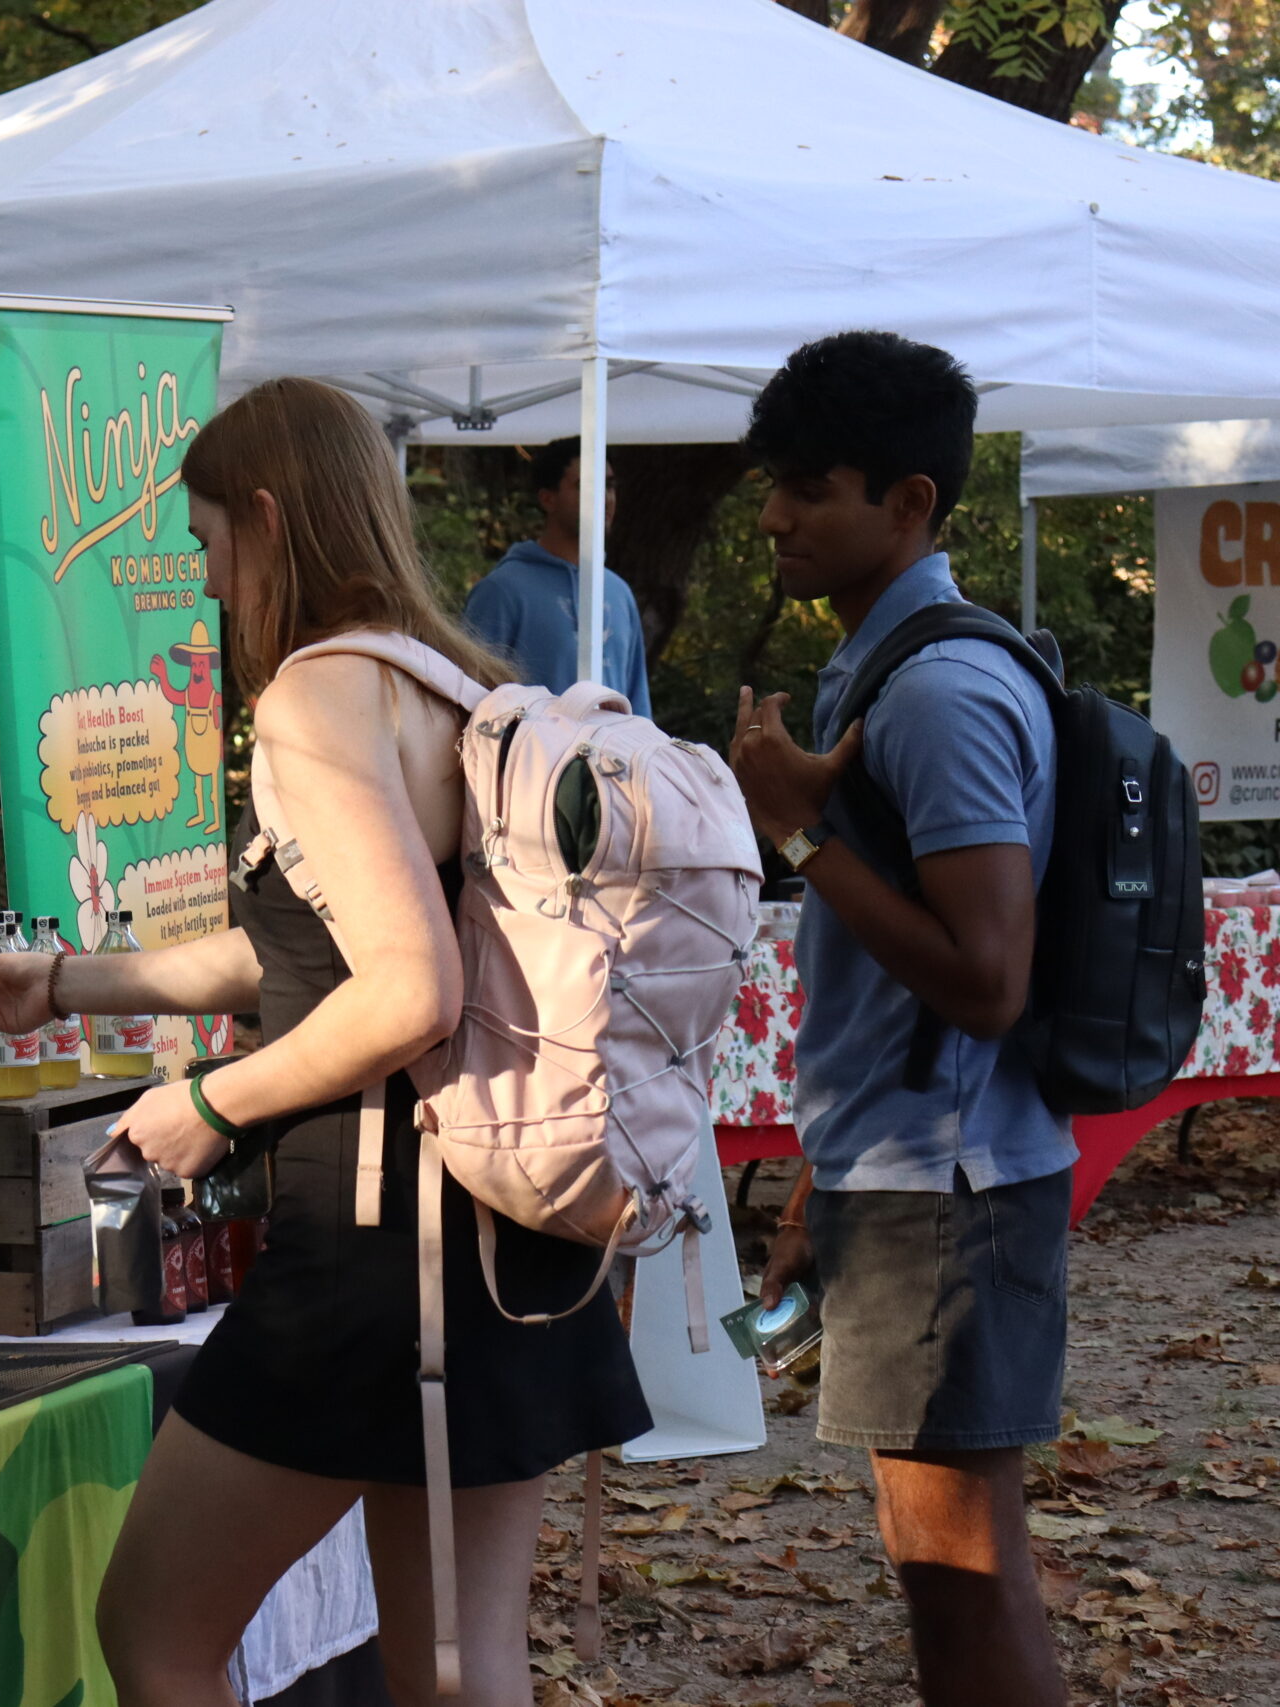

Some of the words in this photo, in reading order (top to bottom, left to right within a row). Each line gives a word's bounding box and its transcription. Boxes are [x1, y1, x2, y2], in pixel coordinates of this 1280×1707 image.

[41, 361, 201, 554] Ninja
[134, 590, 176, 612] BREWING
[180, 588, 195, 608] CO
[87, 707, 115, 729] Health
[118, 706, 145, 724] Boost
[108, 735, 117, 751] is
[119, 729, 150, 755] packed
[116, 755, 158, 779] promoting
[158, 755, 163, 766] a
[91, 783, 104, 801] and
[105, 777, 147, 799] balanced
[148, 779, 160, 798] gut
[144, 876, 174, 894] Immune
[174, 870, 202, 893] System
[1115, 881, 1148, 892] TUMI
[146, 897, 172, 918] Loaded
[172, 894, 187, 912] with
[160, 924, 167, 940] it
[167, 919, 183, 940] helps
[184, 912, 208, 934] fortify
[209, 912, 224, 933] your
